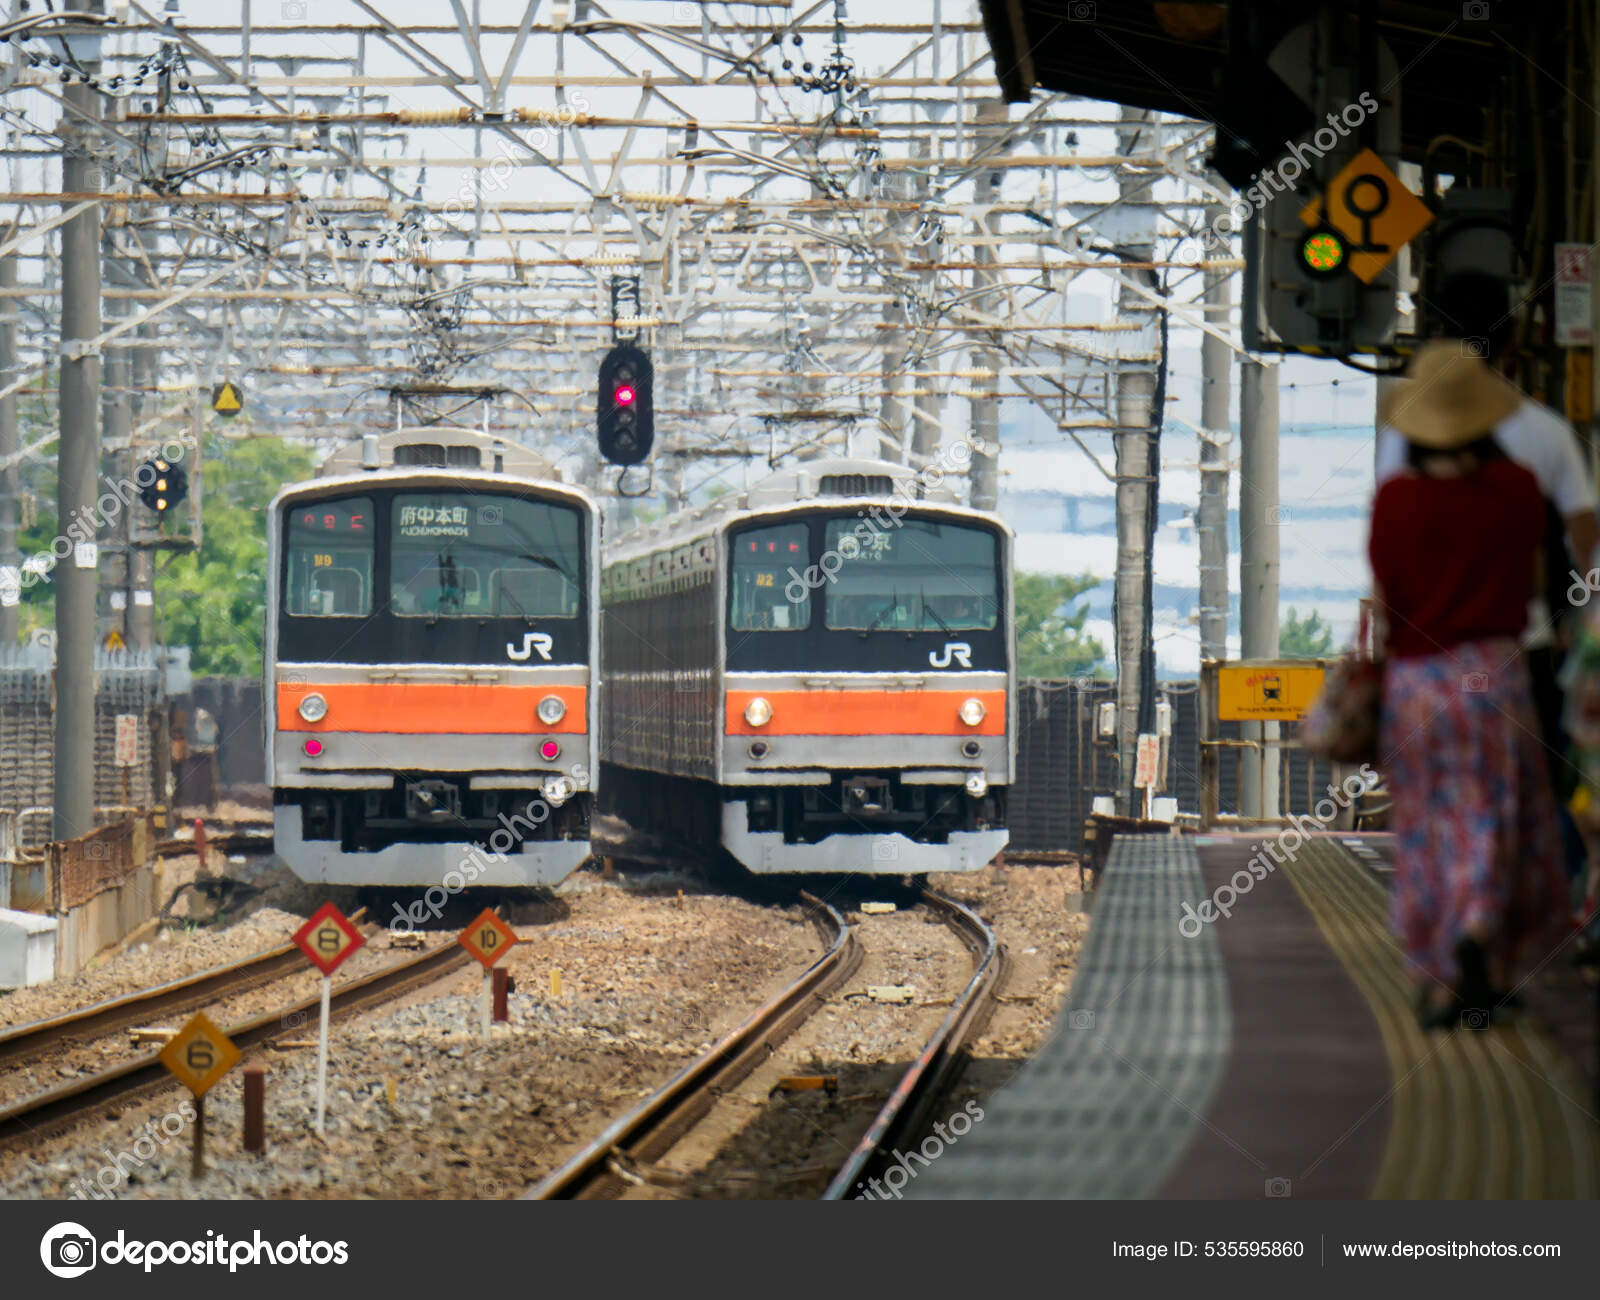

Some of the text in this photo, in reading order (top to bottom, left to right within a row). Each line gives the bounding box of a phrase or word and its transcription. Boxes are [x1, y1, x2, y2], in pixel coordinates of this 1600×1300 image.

[400, 506, 468, 526] 府中本町
[506, 632, 553, 661] JR
[929, 642, 973, 668] JR
[317, 927, 341, 951] 8
[480, 929, 498, 950] 10
[186, 1040, 214, 1069] 6
